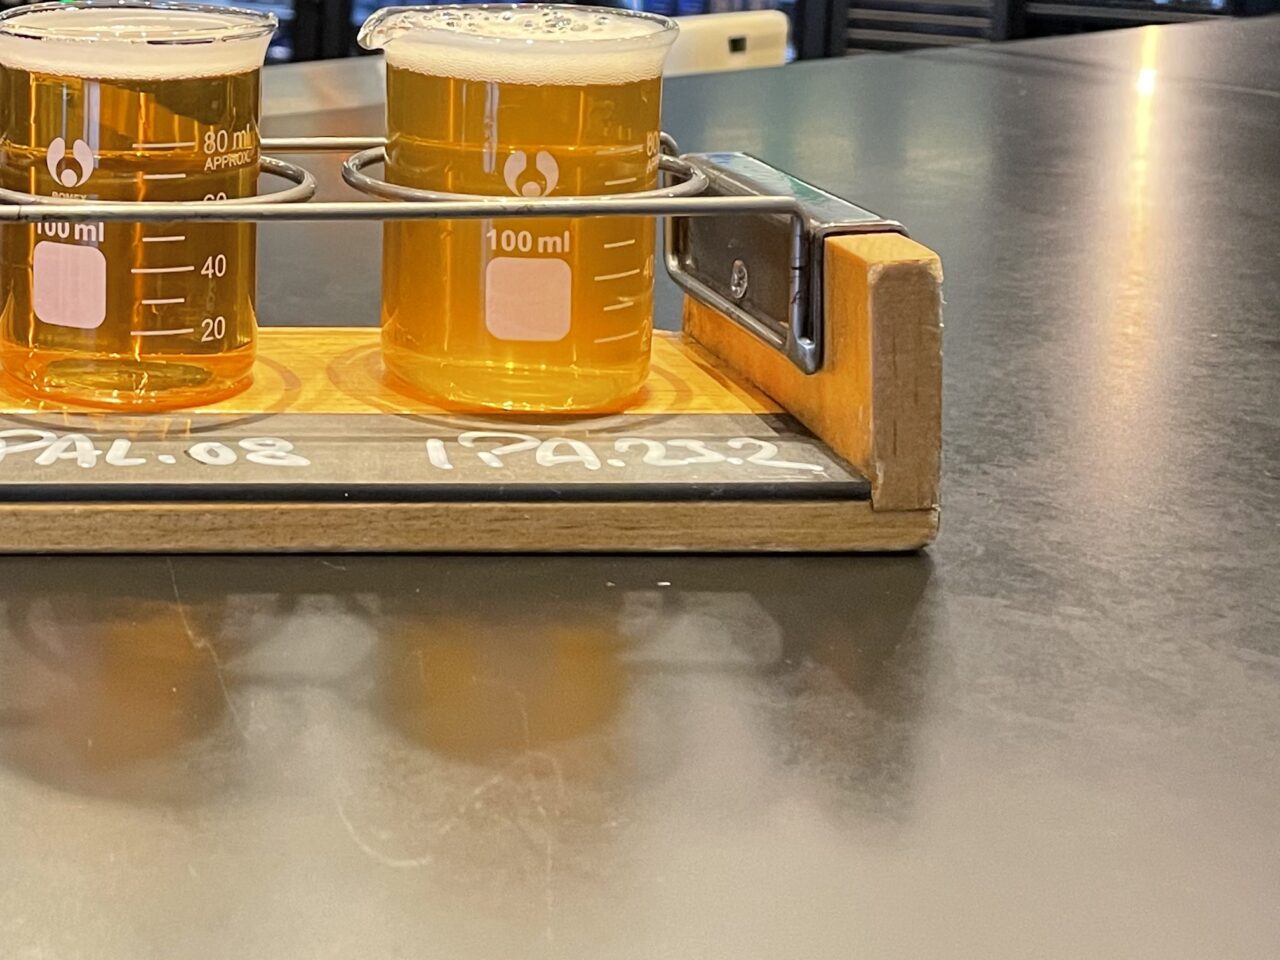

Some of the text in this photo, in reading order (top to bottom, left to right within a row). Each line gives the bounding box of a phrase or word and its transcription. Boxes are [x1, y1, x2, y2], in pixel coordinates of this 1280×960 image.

[204, 129, 228, 155] 80
[74, 221, 104, 242] ml
[486, 228, 570, 253] 100 ml
[200, 254, 227, 279] 40
[201, 316, 226, 342] 20
